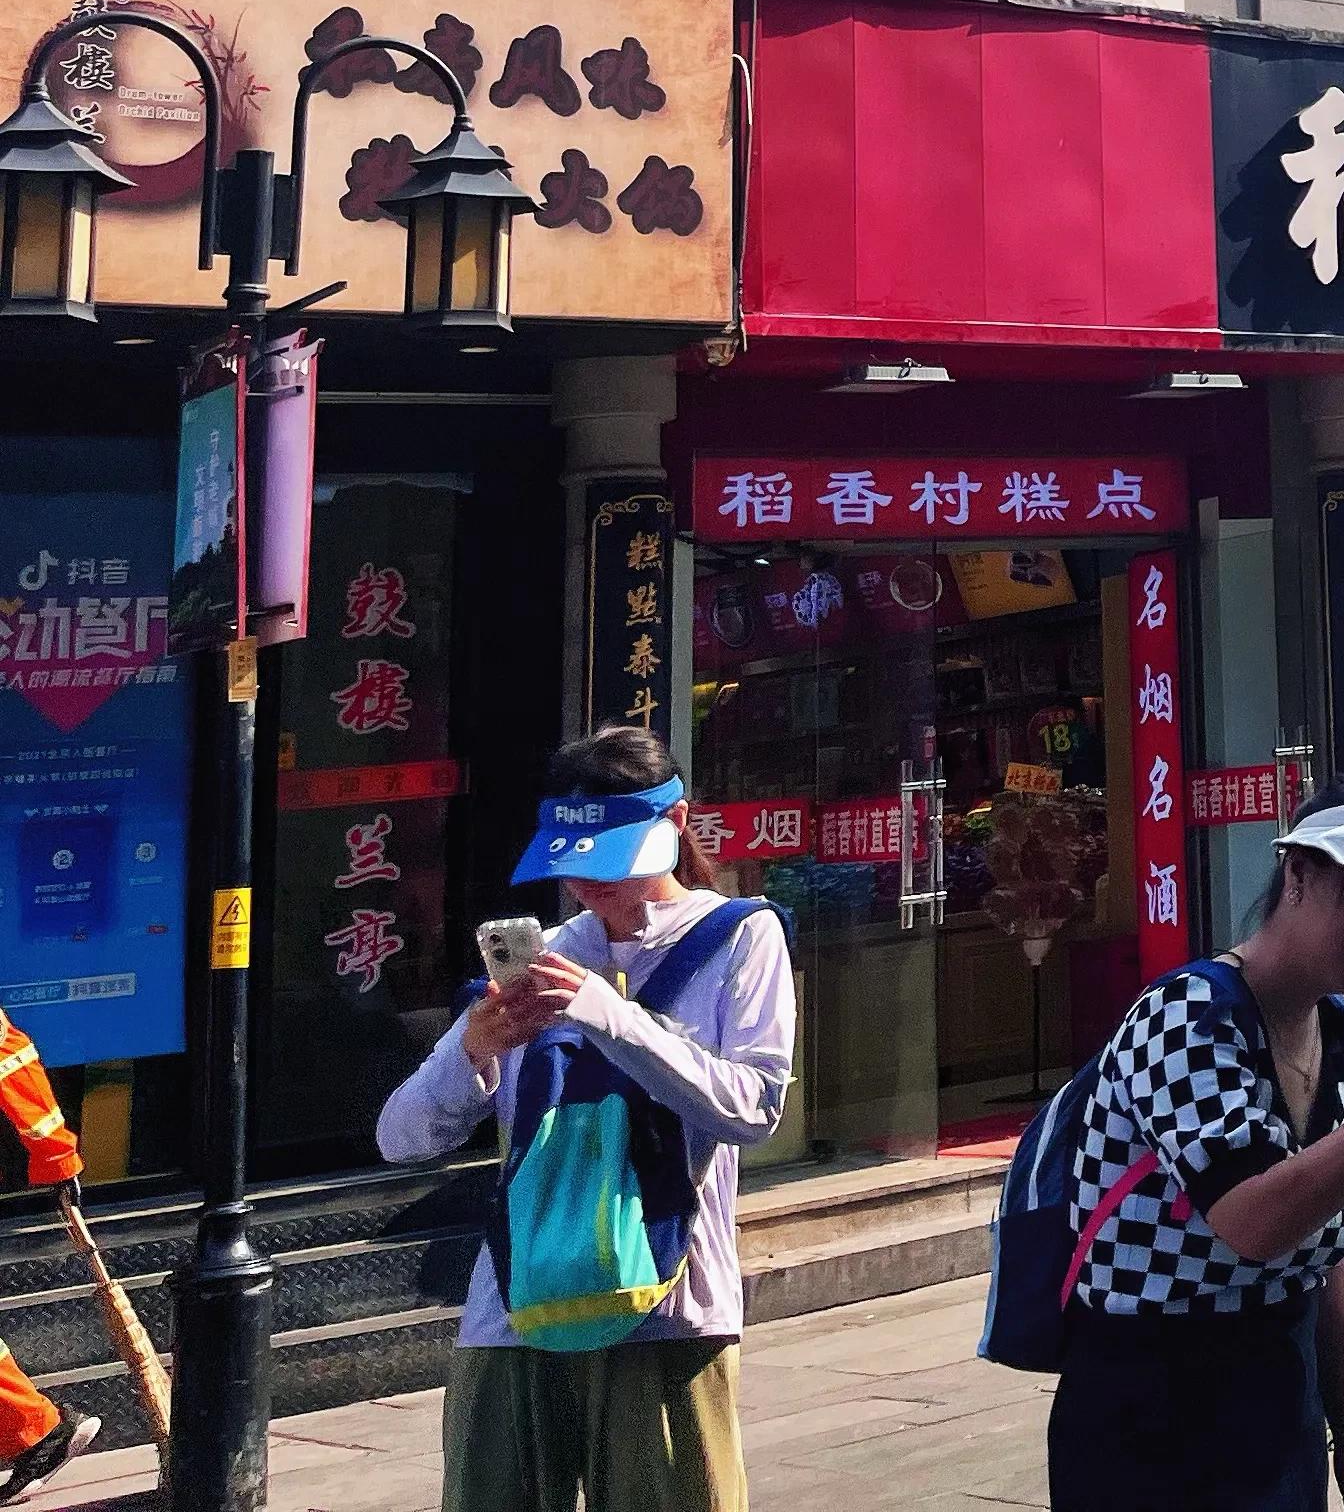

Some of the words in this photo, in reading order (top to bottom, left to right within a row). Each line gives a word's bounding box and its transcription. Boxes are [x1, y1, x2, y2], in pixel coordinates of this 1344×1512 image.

[717, 469, 1157, 528] 稻香村糕点
[67, 557, 131, 586] 抖音
[1136, 565, 1179, 928] 名烟名酒
